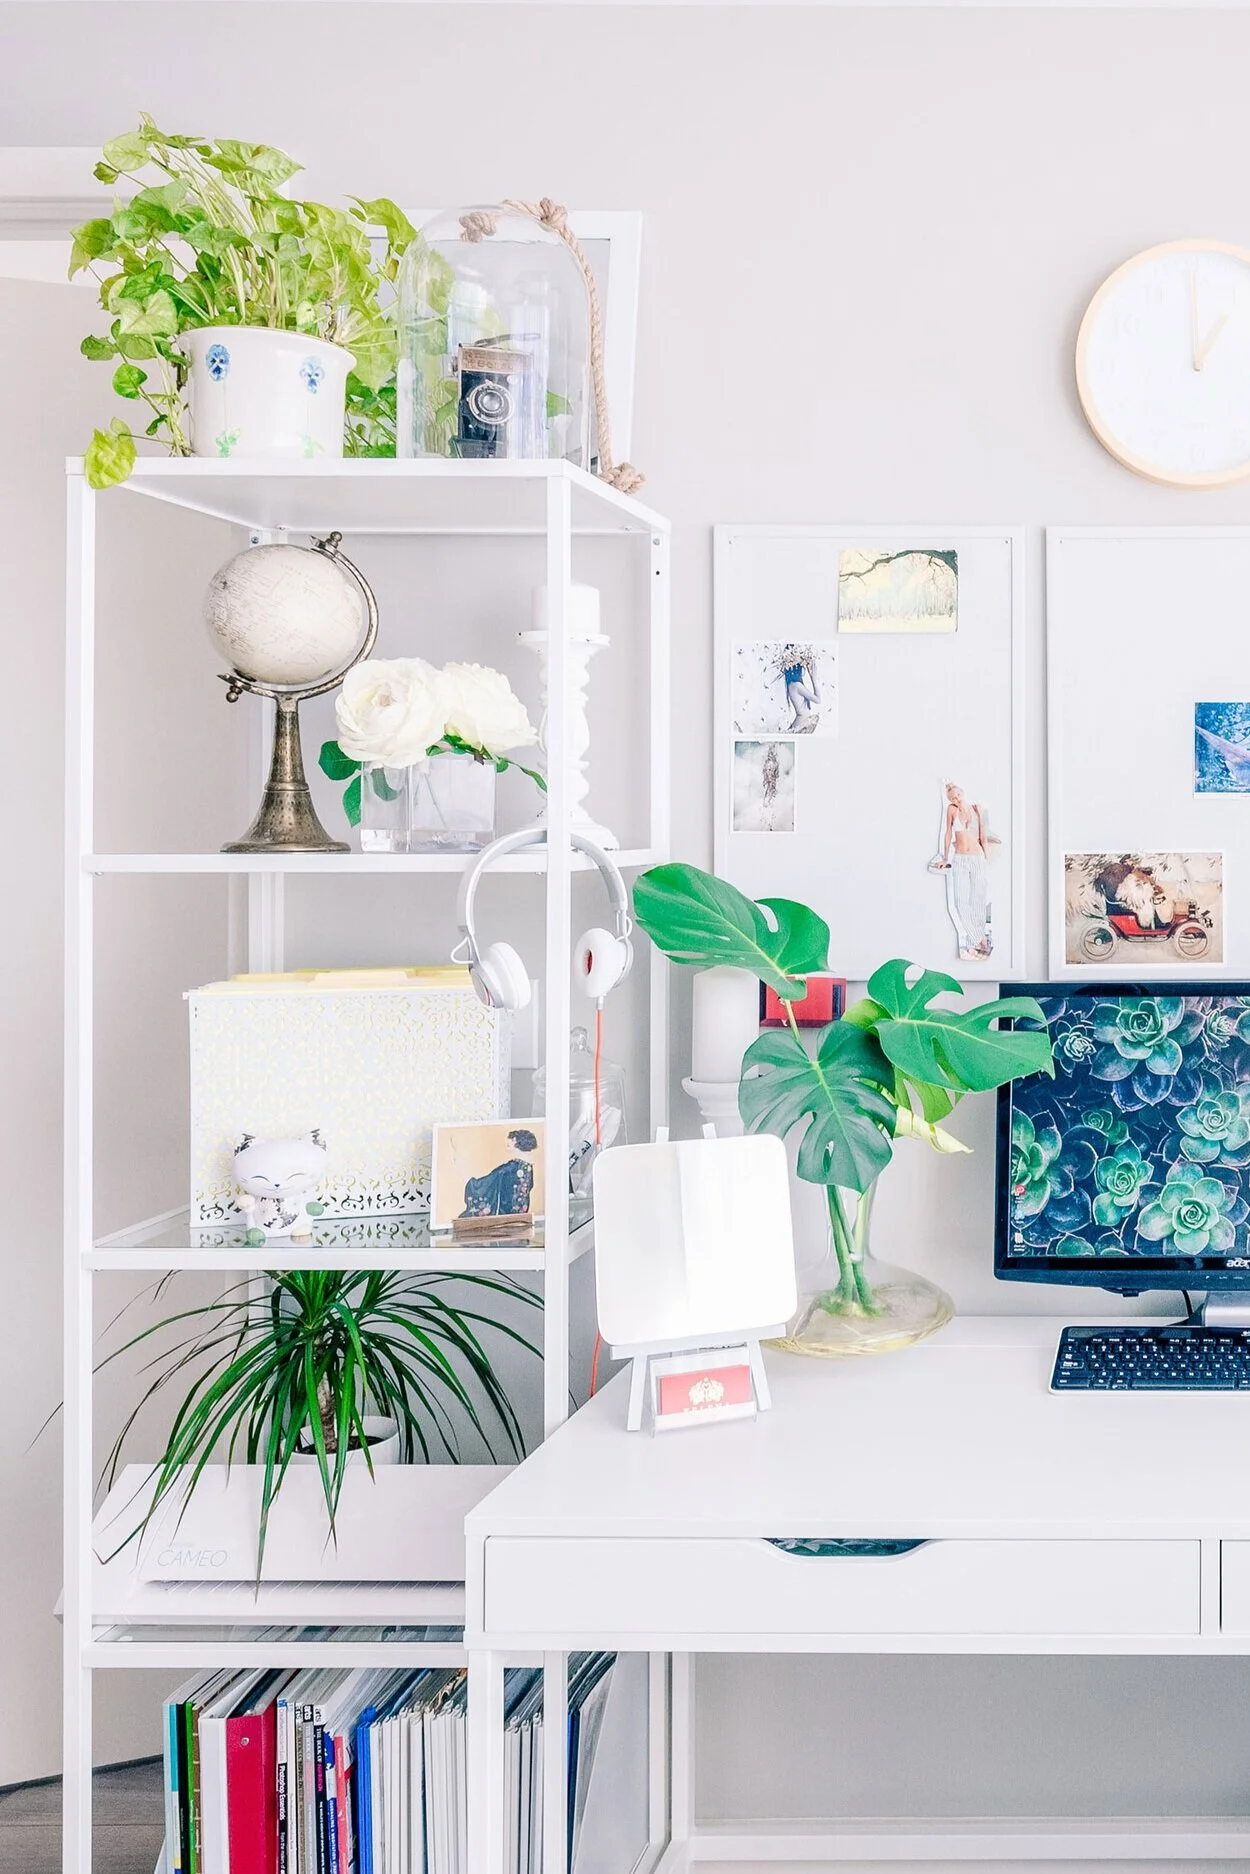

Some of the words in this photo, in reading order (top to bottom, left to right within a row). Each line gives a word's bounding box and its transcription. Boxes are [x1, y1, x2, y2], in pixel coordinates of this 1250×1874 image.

[1226, 1257, 1250, 1269] acer
[157, 1549, 228, 1567] CAMEO
[277, 1765, 285, 1793] Photoshop
